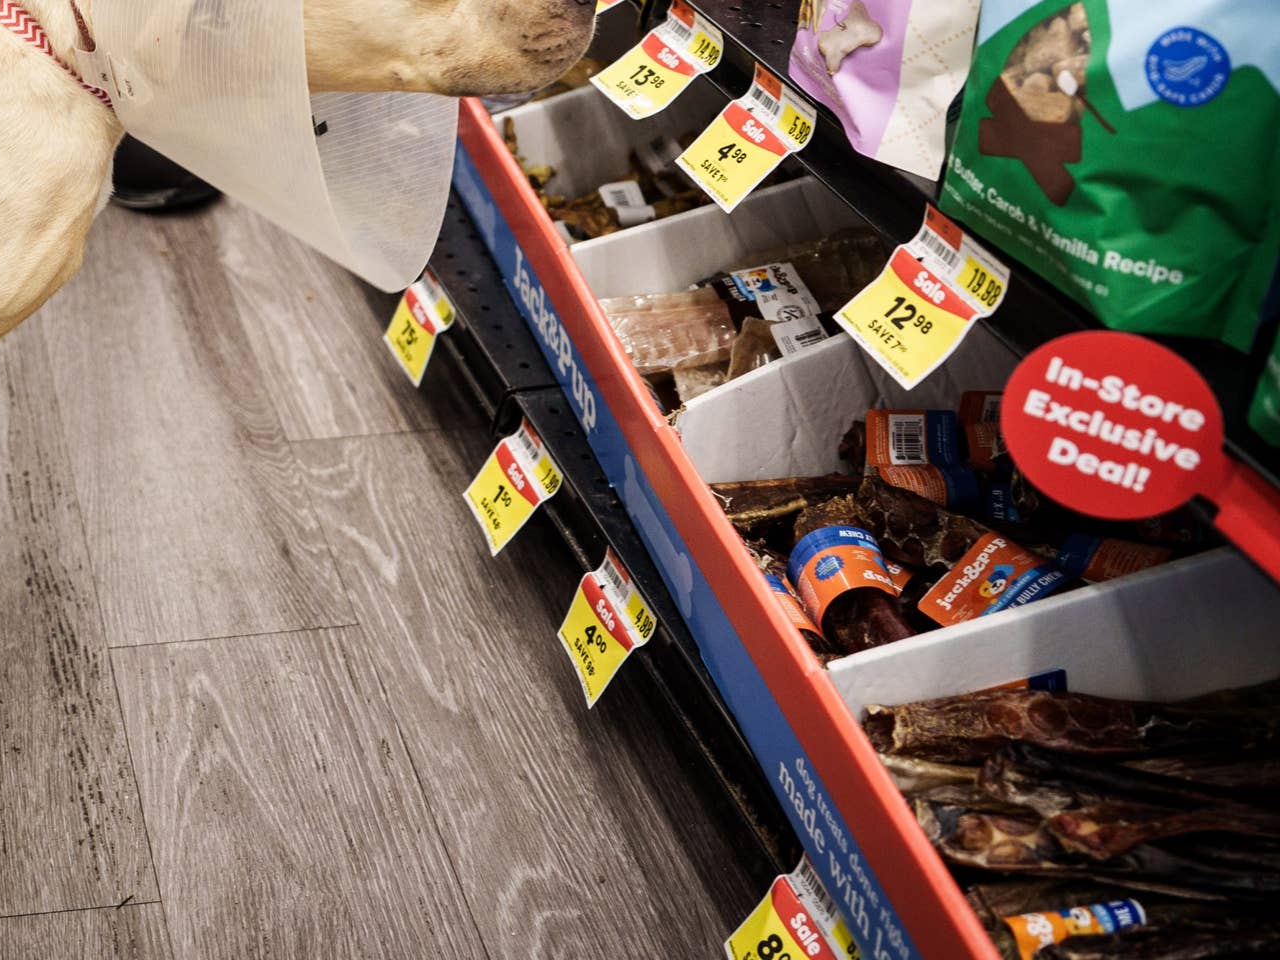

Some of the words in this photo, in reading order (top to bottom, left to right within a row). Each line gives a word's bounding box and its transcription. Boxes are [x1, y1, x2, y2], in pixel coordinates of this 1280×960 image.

[657, 47, 680, 69] Sale
[741, 119, 767, 144] Sale
[787, 116, 812, 144] 5.98
[986, 188, 1027, 224] Carob
[1041, 224, 1100, 265] Vanilla
[1103, 251, 1185, 286] Recipe
[913, 271, 947, 304] Sale
[967, 268, 1002, 307] 19.98
[868, 319, 894, 344] SAVE
[1045, 356, 1205, 431] In-Store
[1023, 388, 1201, 470] Exclusive
[507, 462, 525, 490] Sale
[1047, 436, 1151, 492] Deal!
[1018, 582, 1040, 606] BULLY
[595, 599, 616, 631] Sale
[635, 608, 654, 639] 4.98
[795, 757, 816, 800] dog
[817, 793, 848, 854] treats
[849, 853, 880, 908] done
[779, 761, 824, 854] made
[828, 851, 869, 940] with
[790, 912, 821, 955] Sale
